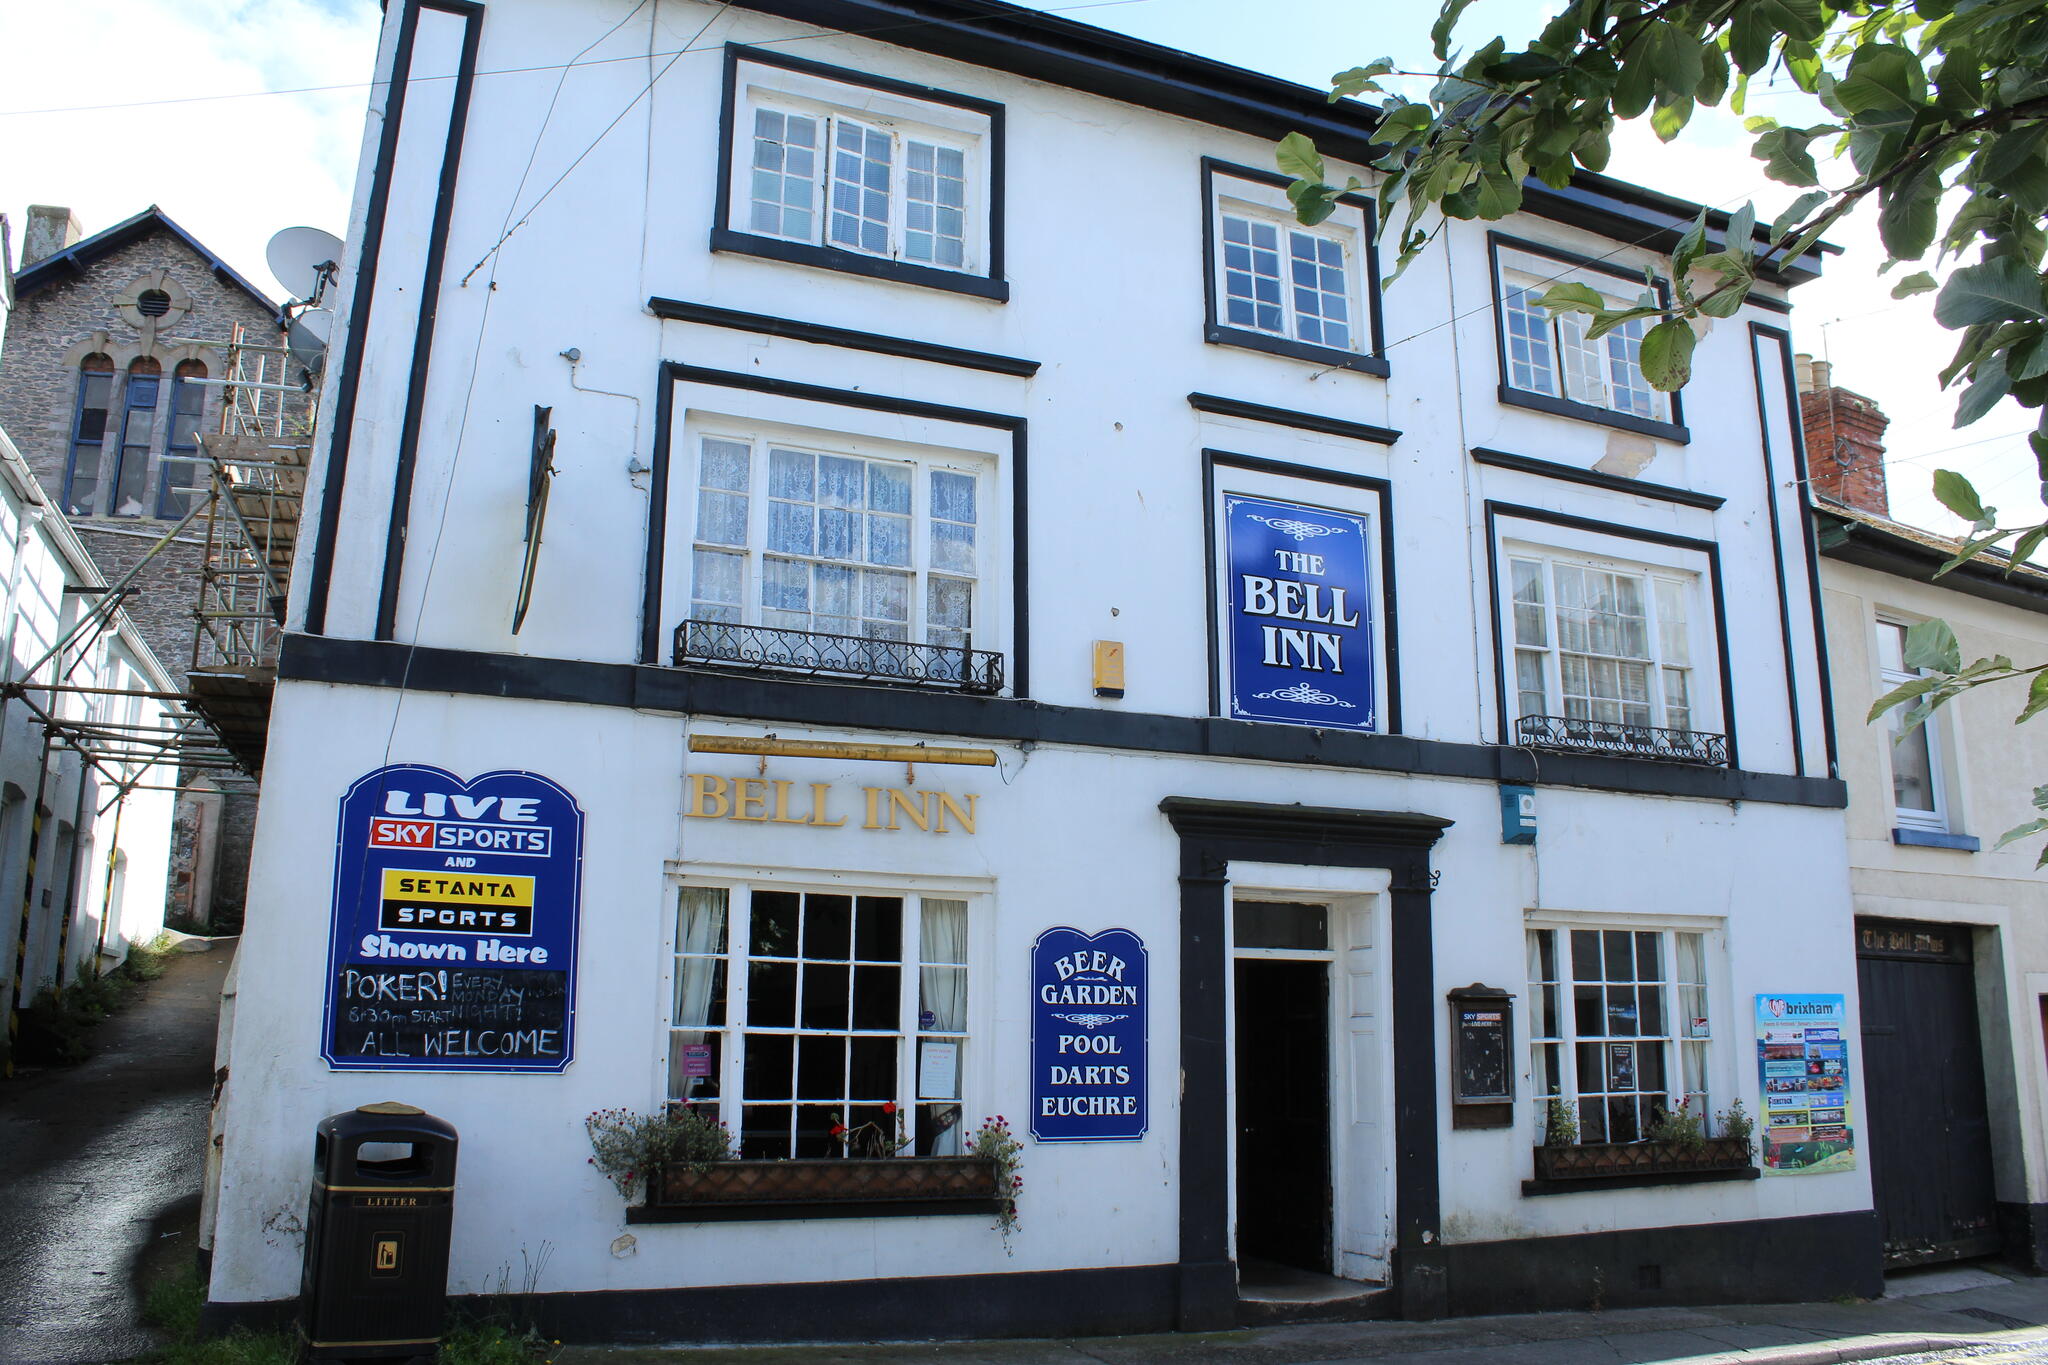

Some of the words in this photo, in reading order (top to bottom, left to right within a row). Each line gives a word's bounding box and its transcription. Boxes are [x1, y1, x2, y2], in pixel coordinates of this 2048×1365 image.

[1274, 549, 1326, 577] THE
[1242, 574, 1359, 627] BELL
[1262, 626, 1343, 673] INN
[385, 790, 541, 822] LIVE
[683, 773, 848, 828] BELL
[861, 786, 982, 835] INN
[377, 823, 430, 844] SKY
[439, 827, 545, 851] SPORTS
[445, 856, 476, 868] AND
[400, 878, 516, 898] SETANTA
[398, 908, 517, 927] SPORTS
[360, 934, 467, 961] Shown
[476, 939, 549, 964] Here
[1054, 950, 1126, 982] BEER
[344, 969, 448, 1001] POKER!
[1041, 984, 1138, 1005] GARDEN
[1786, 1002, 1833, 1015] brixham
[360, 1031, 411, 1057] ALL
[424, 1029, 560, 1057] WELCOME
[1058, 1034, 1122, 1054] POOL
[1050, 1065, 1130, 1085] DARTS
[1041, 1095, 1138, 1116] EUCHRE
[367, 1197, 417, 1206] LITTER
